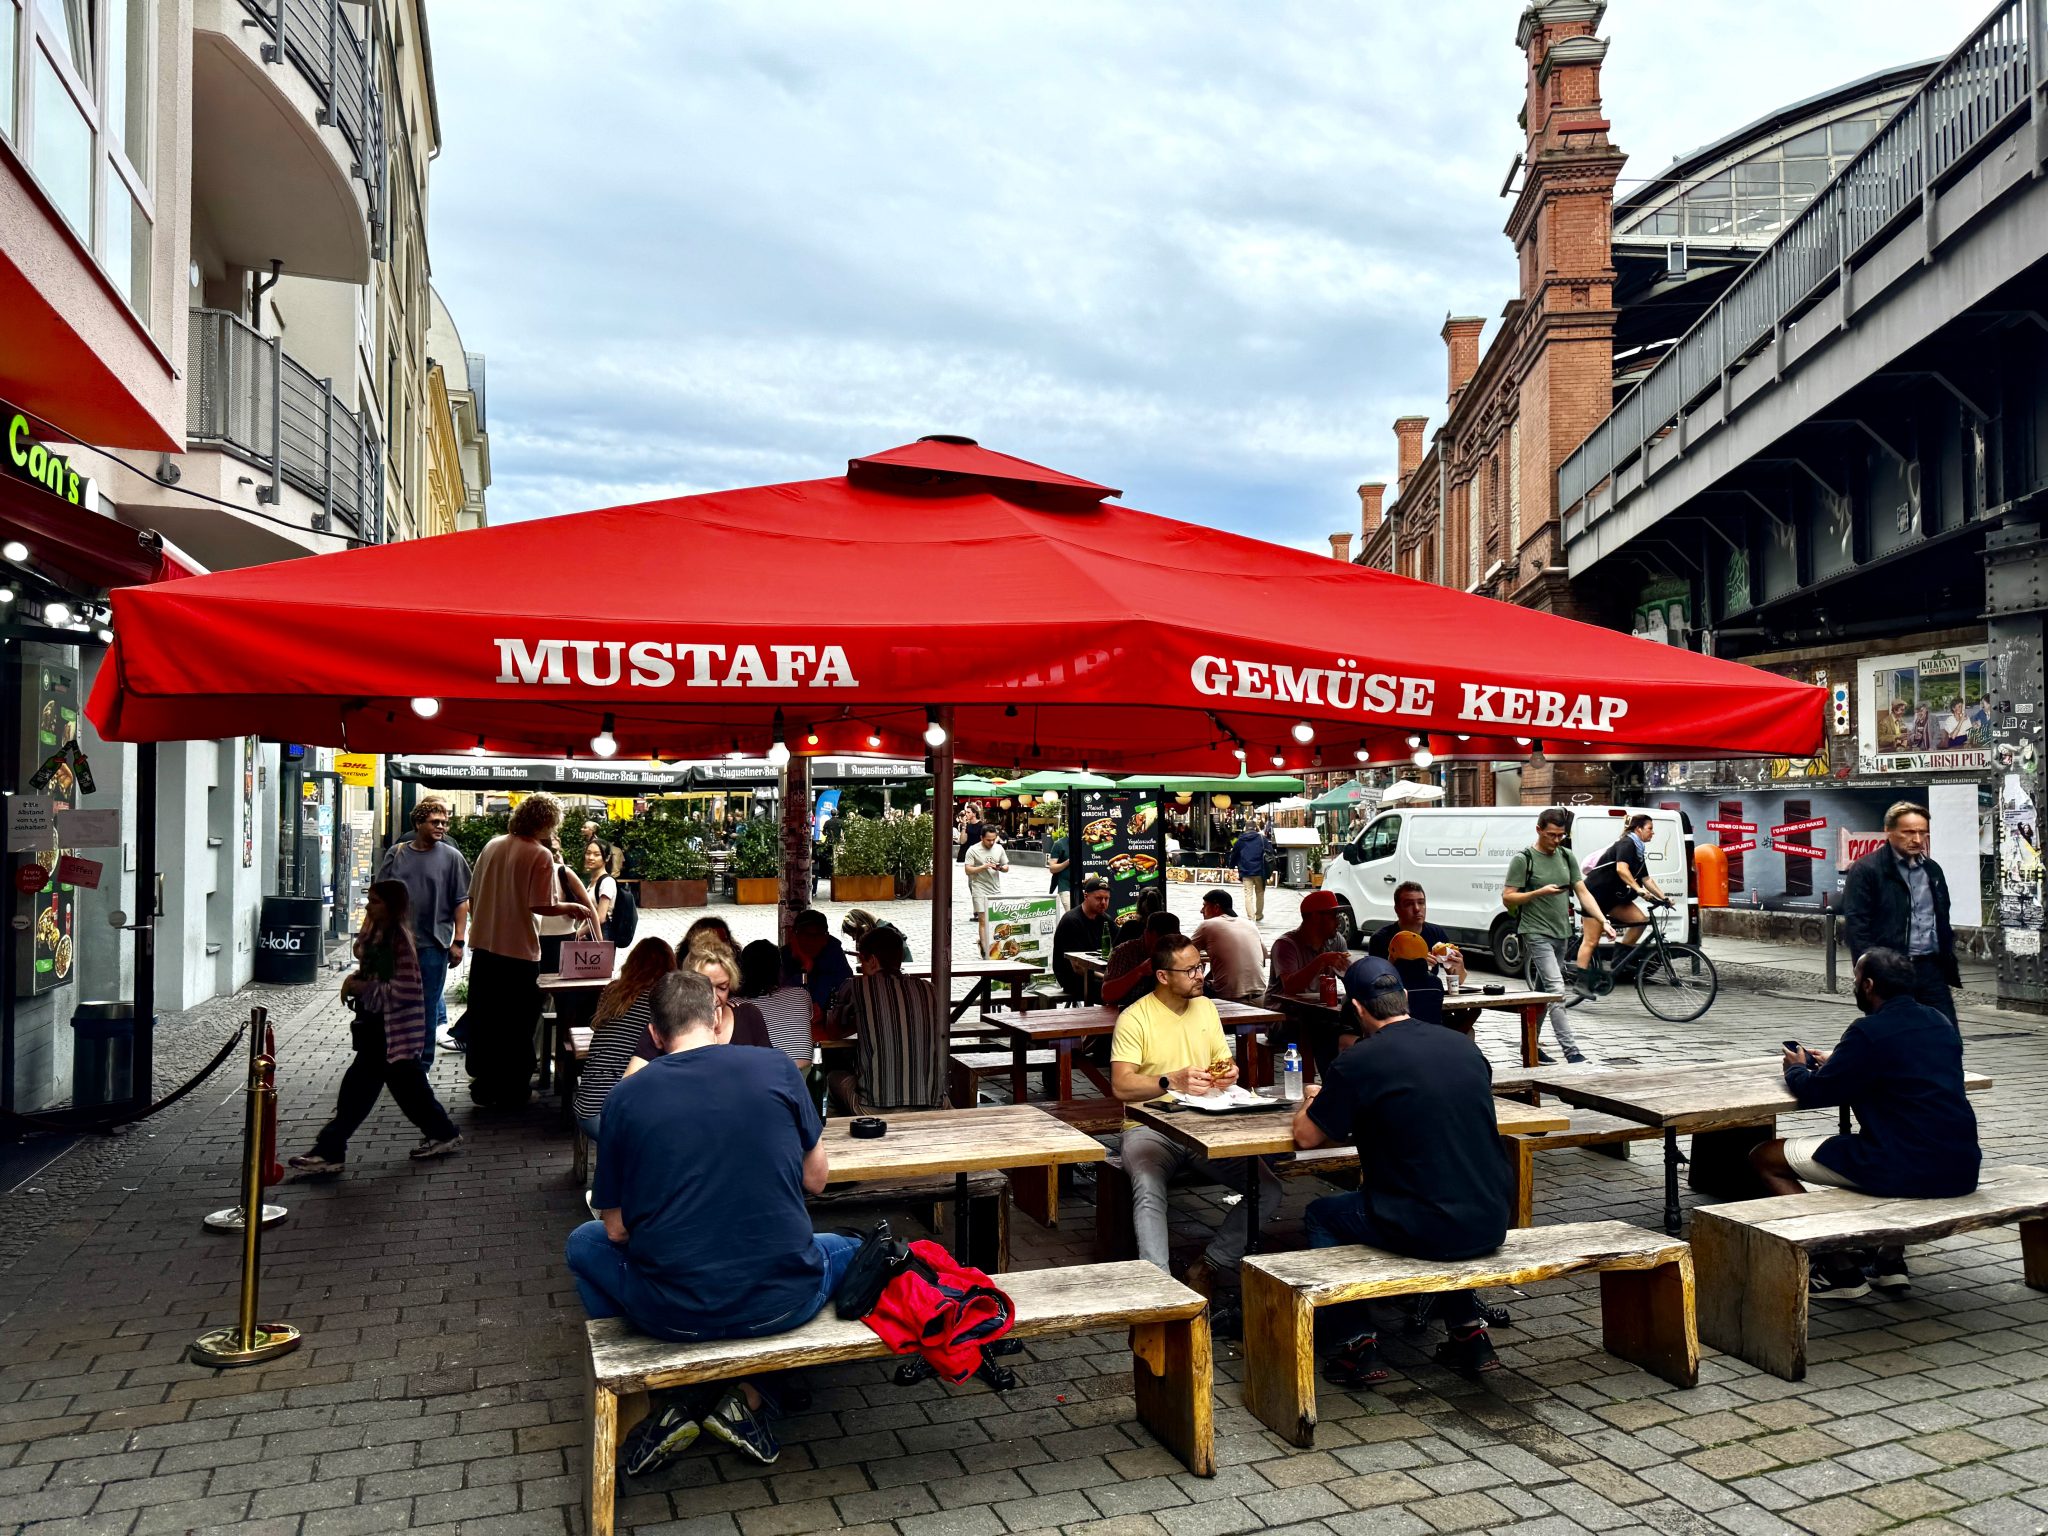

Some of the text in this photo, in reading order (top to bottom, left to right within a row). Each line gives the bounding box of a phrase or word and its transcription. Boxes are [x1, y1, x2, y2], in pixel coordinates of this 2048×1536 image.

[9, 414, 80, 505] Can's
[494, 638, 859, 688] MUSTAFA
[1921, 657, 1957, 670] KILKENNY
[1190, 655, 1435, 716] GEMÜSE
[1458, 682, 1628, 732] KEBAP
[1930, 754, 1958, 768] IRISH
[1962, 752, 1984, 766] PUB
[492, 766, 528, 777] München
[641, 771, 675, 783] München
[1736, 841, 1754, 850] PLASTIC
[1803, 848, 1824, 856] PLASTIC
[69, 864, 93, 875] Offen
[992, 902, 1031, 916] Vegane
[1009, 907, 1057, 923] Speisekarte
